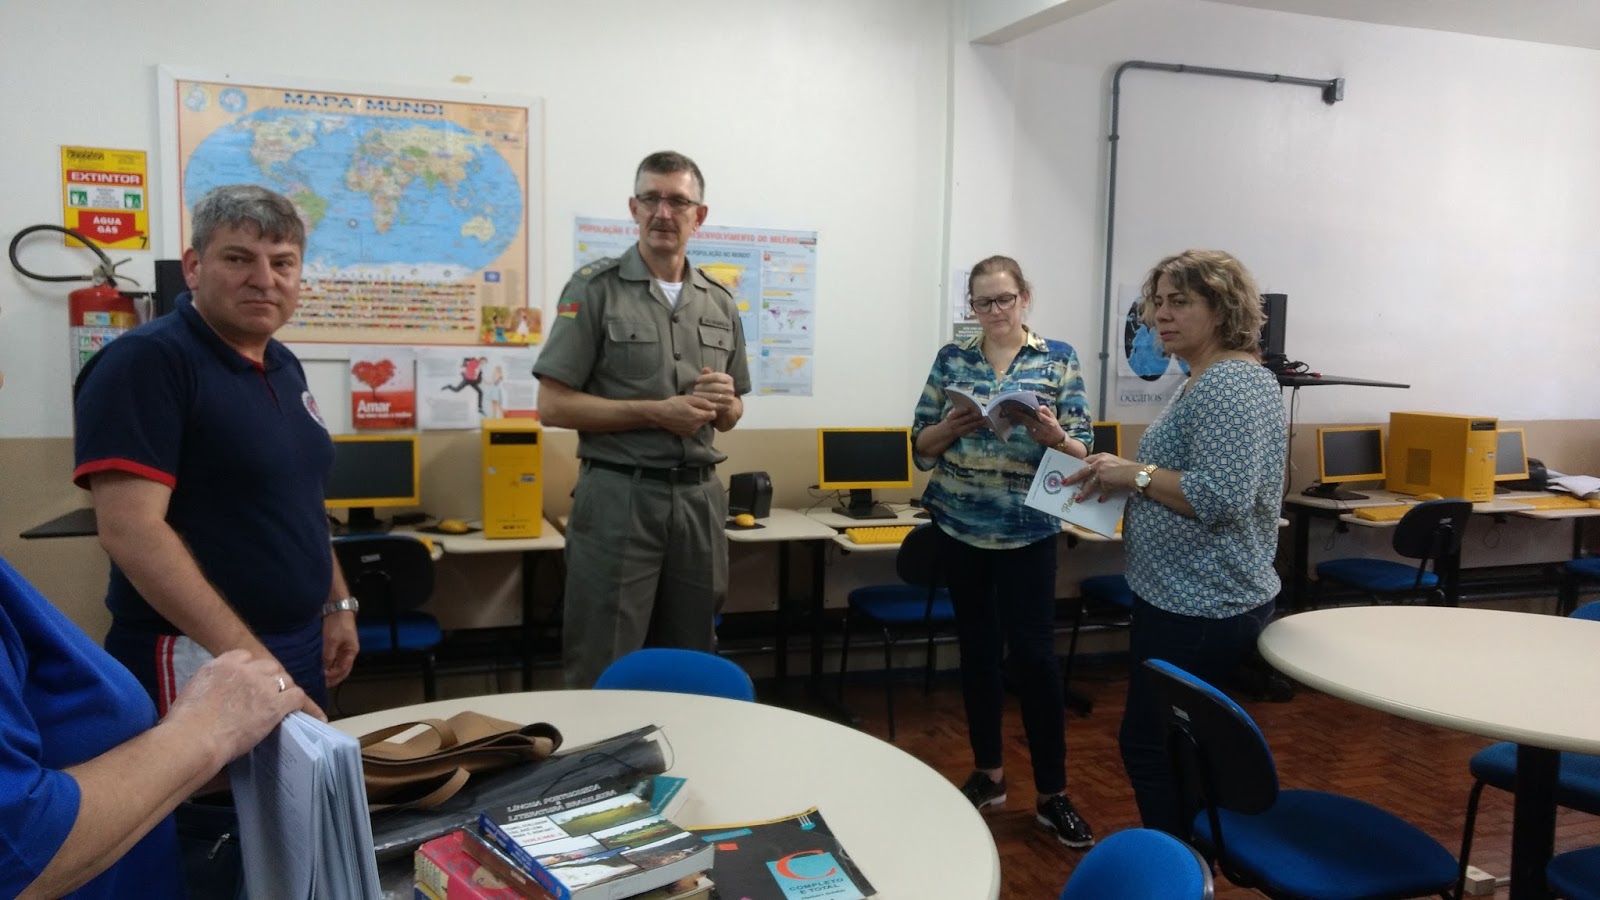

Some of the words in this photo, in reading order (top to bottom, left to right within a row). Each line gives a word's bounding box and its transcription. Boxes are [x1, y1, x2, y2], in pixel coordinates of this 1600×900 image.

[284, 92, 354, 109] MAPA
[366, 98, 444, 115] MUNDI
[71, 171, 141, 184] EXTINTOR
[140, 236, 147, 249] 7
[757, 234, 768, 243] DO
[357, 400, 392, 413] Amar
[507, 800, 542, 813] LÍNGUA
[543, 783, 601, 805] PORTUGUESA
[508, 804, 565, 822] LITERATURA
[565, 789, 618, 809] BRASILEIRA
[776, 849, 836, 880] C
[789, 878, 844, 891] COMPLETO
[809, 884, 840, 892] TOTAL
